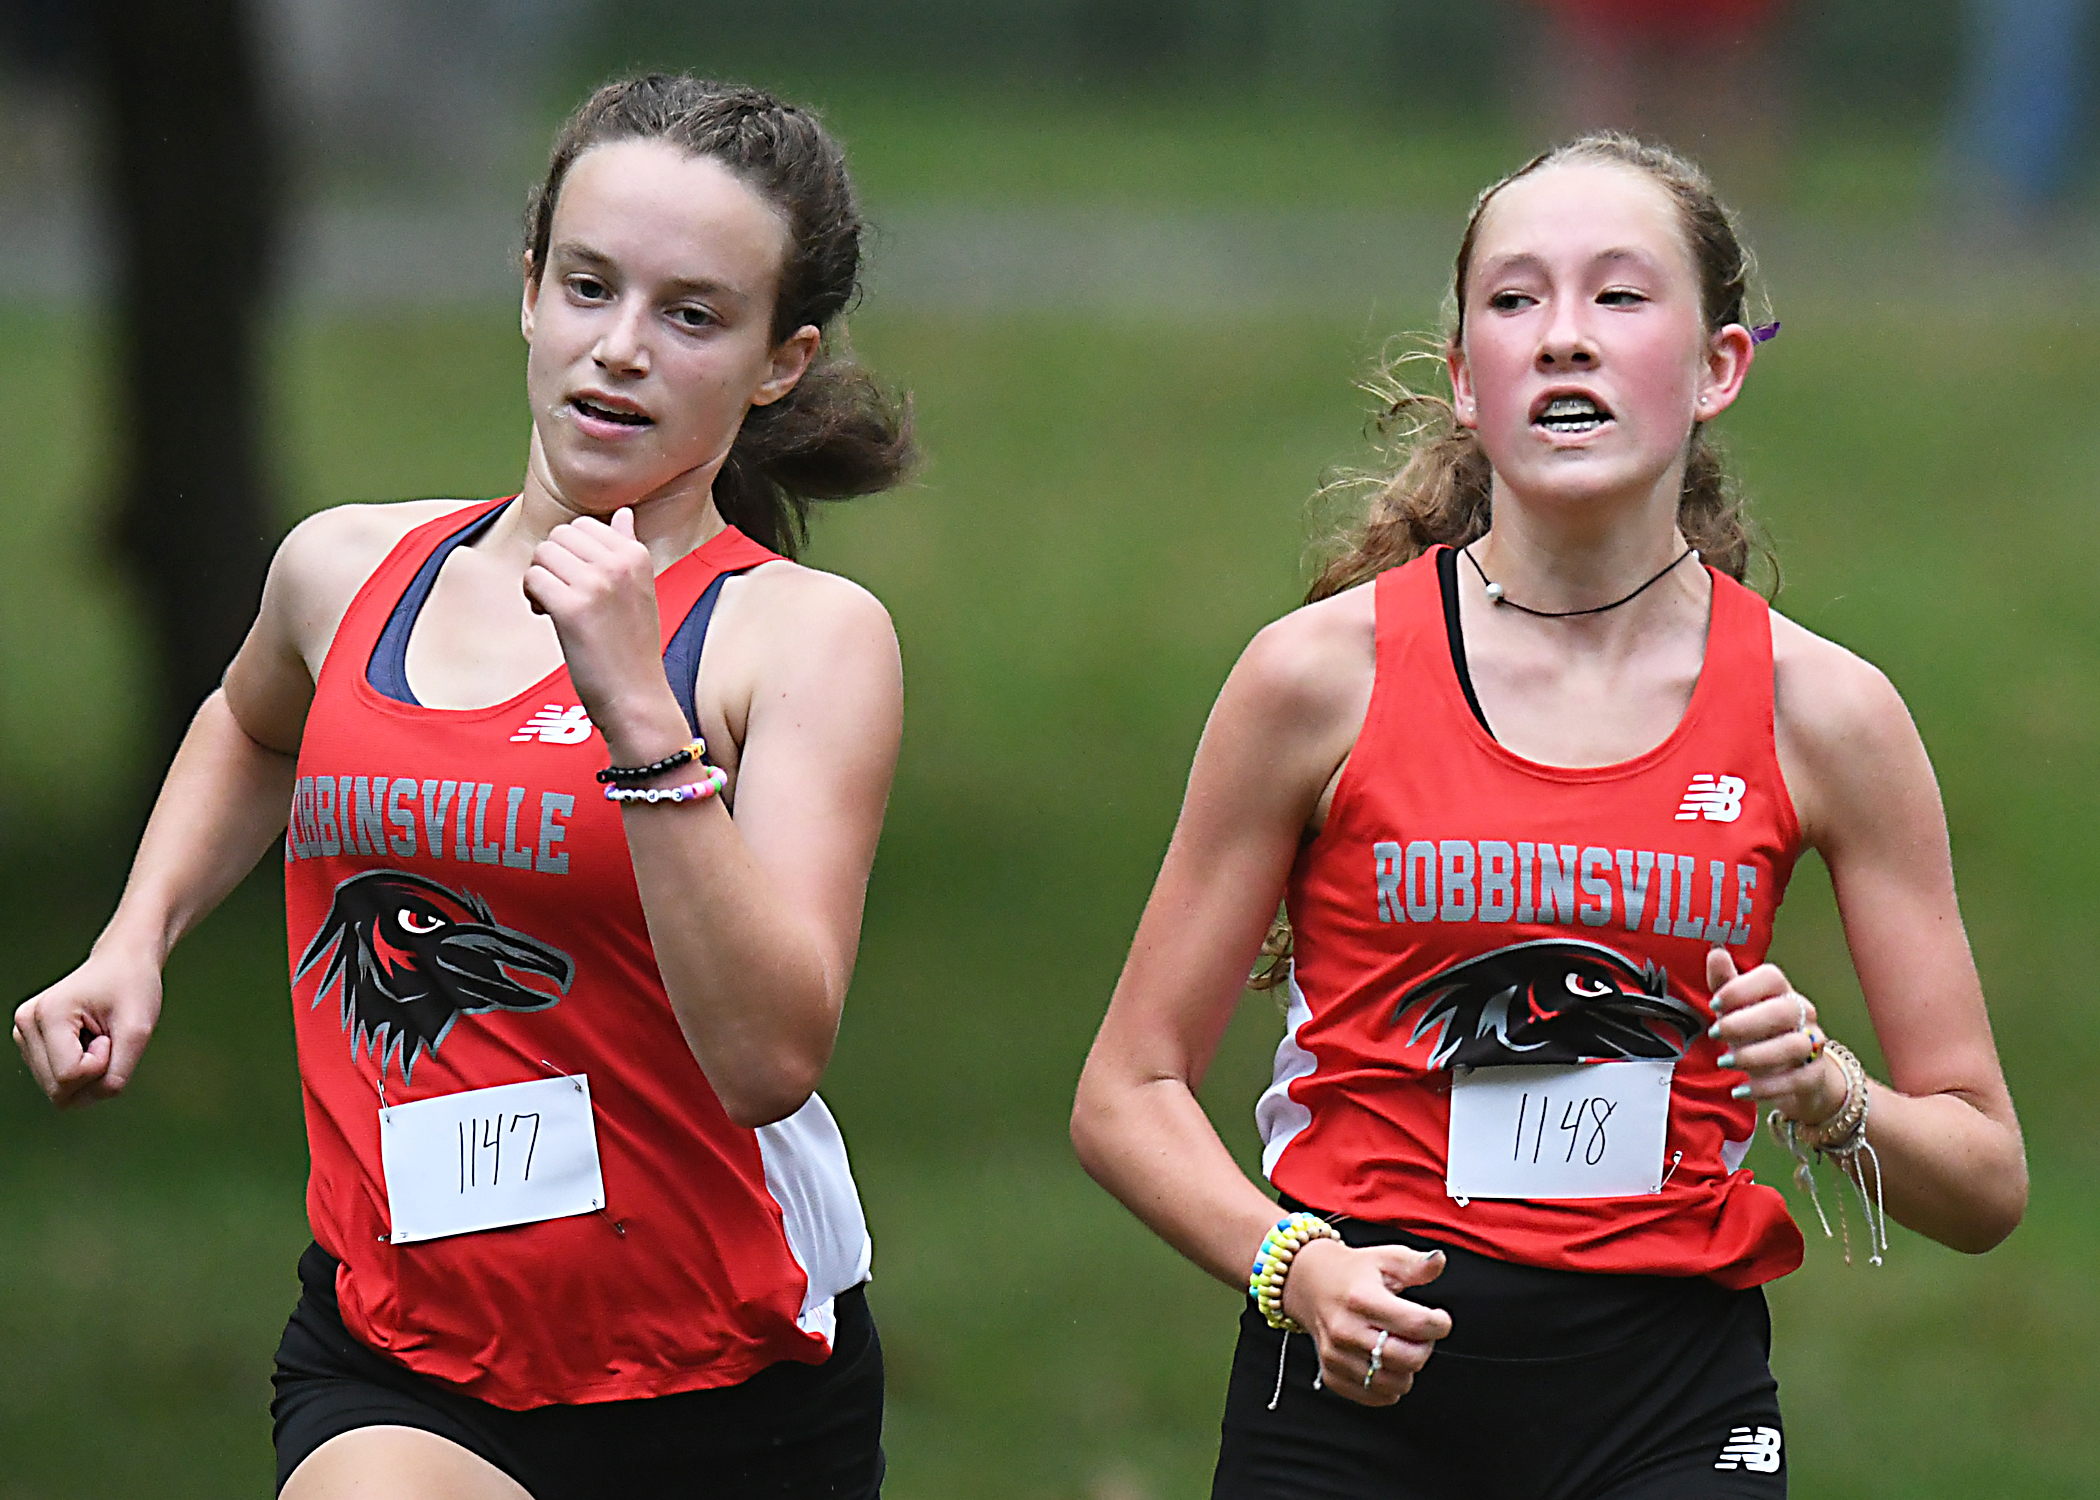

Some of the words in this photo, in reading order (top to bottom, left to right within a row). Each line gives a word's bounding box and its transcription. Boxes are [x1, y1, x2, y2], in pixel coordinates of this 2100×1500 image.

[285, 776, 575, 874] OBBINSVILLE
[1674, 774, 1746, 822] NB
[1373, 840, 1757, 944] ROBBINSVILLE
[459, 1113, 540, 1194] 1147
[1514, 1093, 1617, 1165] 1148
[1714, 1426, 1781, 1473] NB
